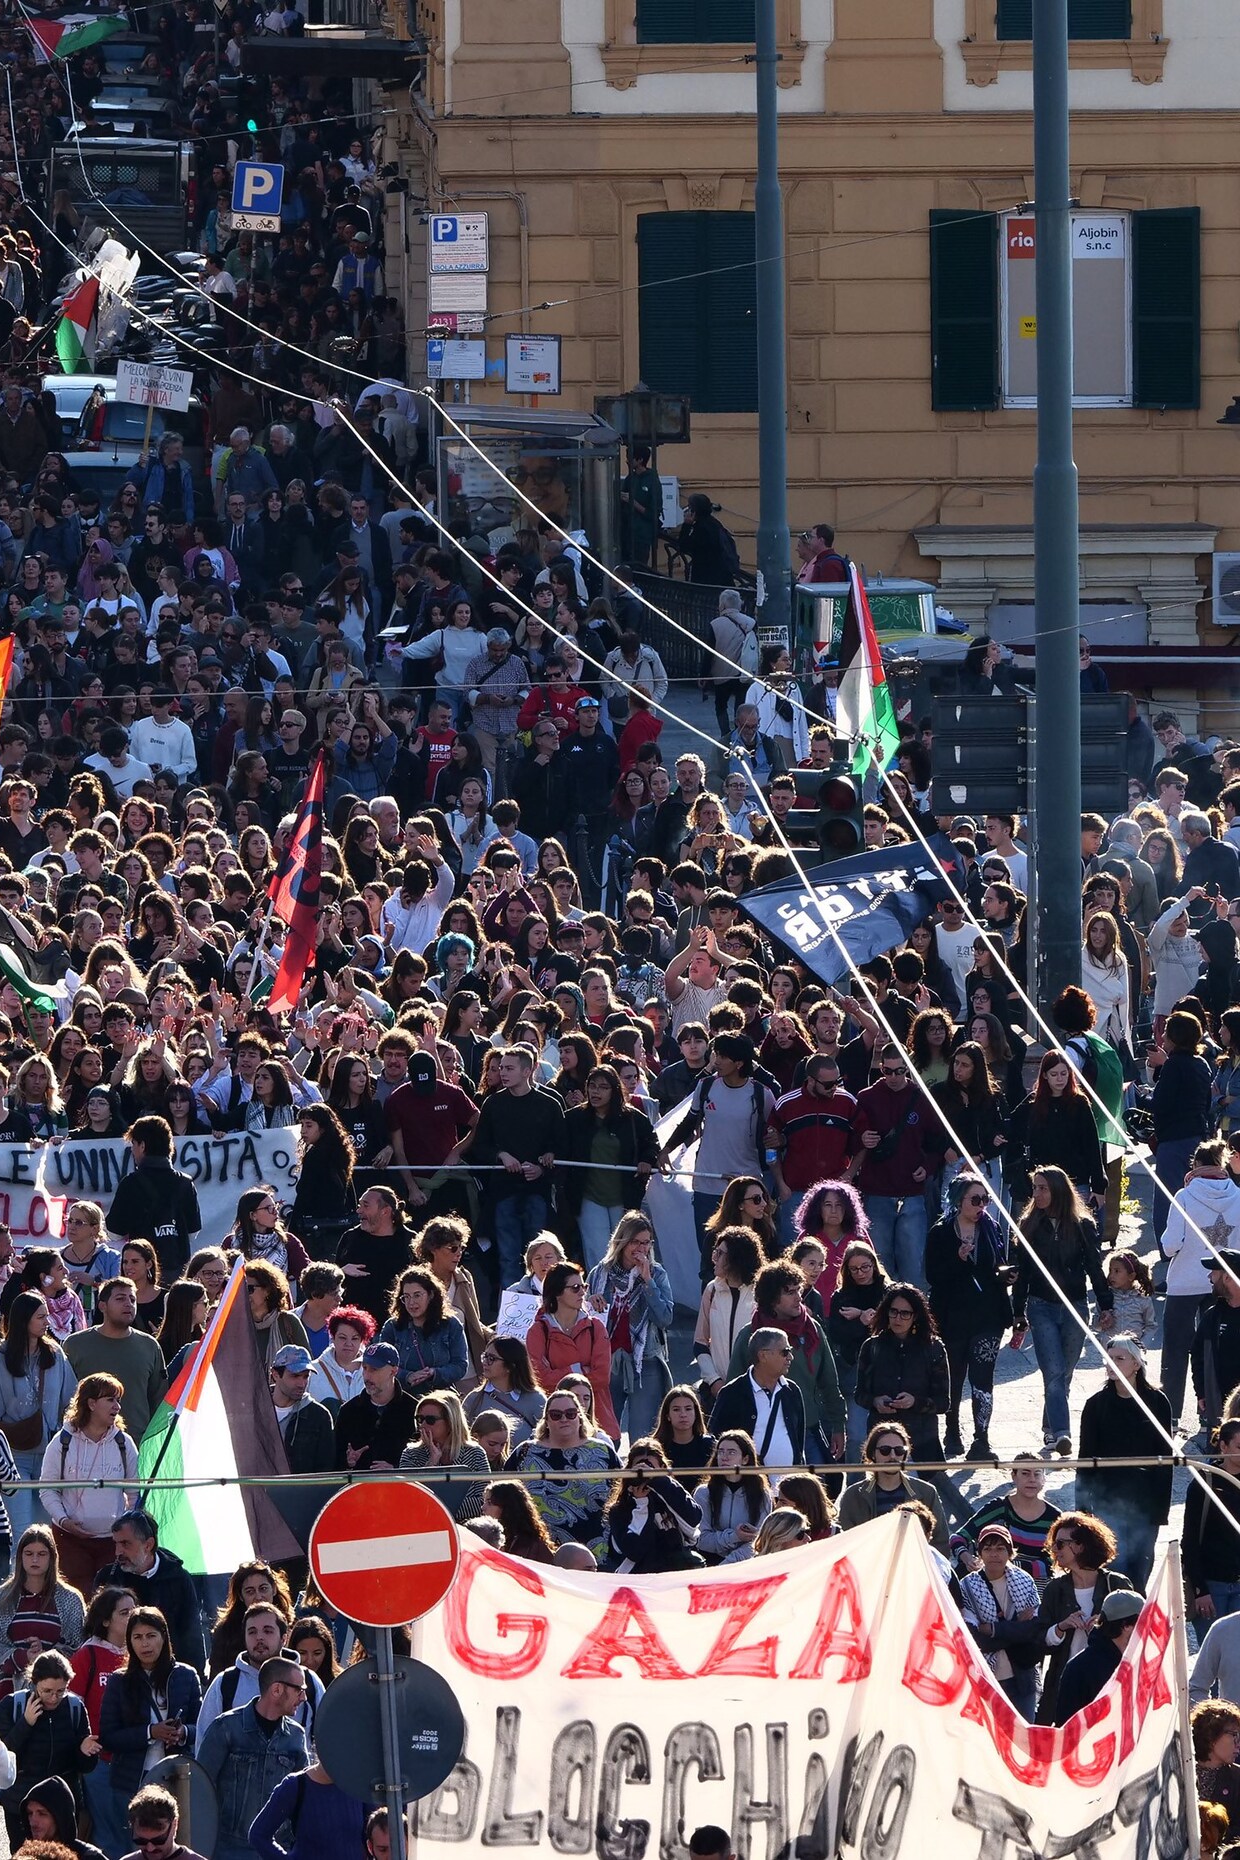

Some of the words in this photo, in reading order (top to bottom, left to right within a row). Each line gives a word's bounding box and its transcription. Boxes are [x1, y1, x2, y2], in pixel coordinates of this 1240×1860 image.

[242, 168, 274, 207] P
[437, 220, 453, 240] P
[1010, 231, 1034, 247] ria
[1078, 228, 1118, 239] Aljobin
[1086, 241, 1111, 250] s.n.c
[141, 388, 173, 406] FINITA!
[54, 1131, 263, 1193] UNIVSITÀ
[444, 1548, 871, 1684] GAZA
